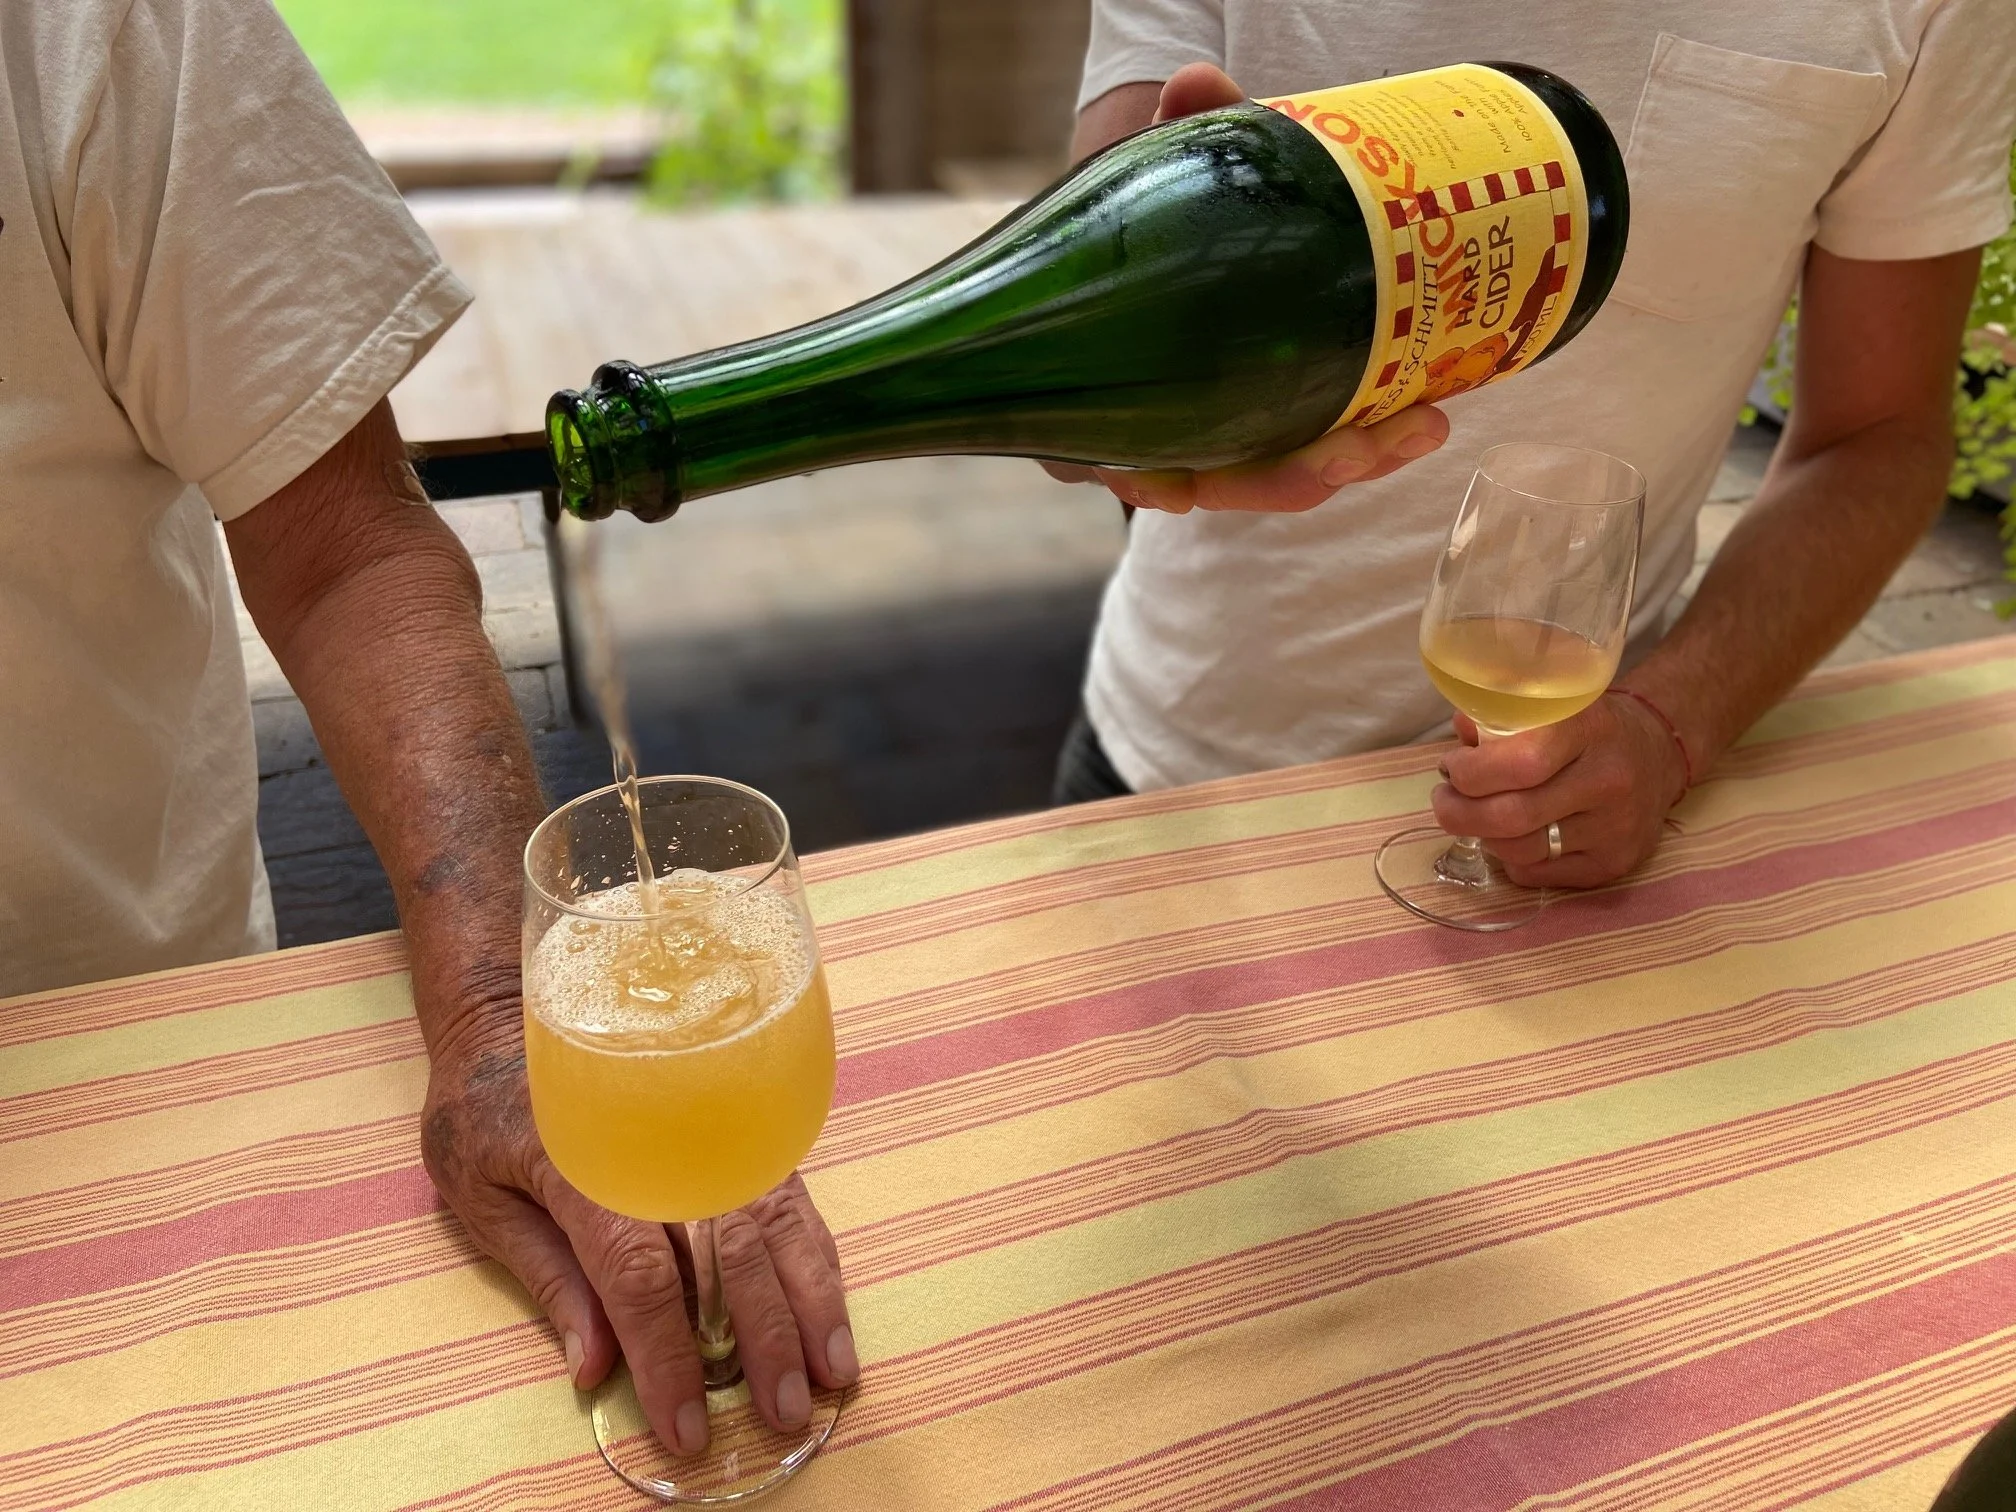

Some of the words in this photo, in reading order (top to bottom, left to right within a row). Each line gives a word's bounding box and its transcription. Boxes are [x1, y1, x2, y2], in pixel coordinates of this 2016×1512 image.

[1477, 109, 1490, 119] on
[1480, 98, 1499, 114] with
[1489, 94, 1514, 115] Apple
[1488, 122, 1511, 153] Made
[1511, 117, 1532, 141] 100%
[1268, 99, 1466, 336] WICKSON
[1455, 237, 1482, 329] HARD
[1479, 215, 1514, 330] CIDER
[1404, 256, 1438, 376] SCHMITT
